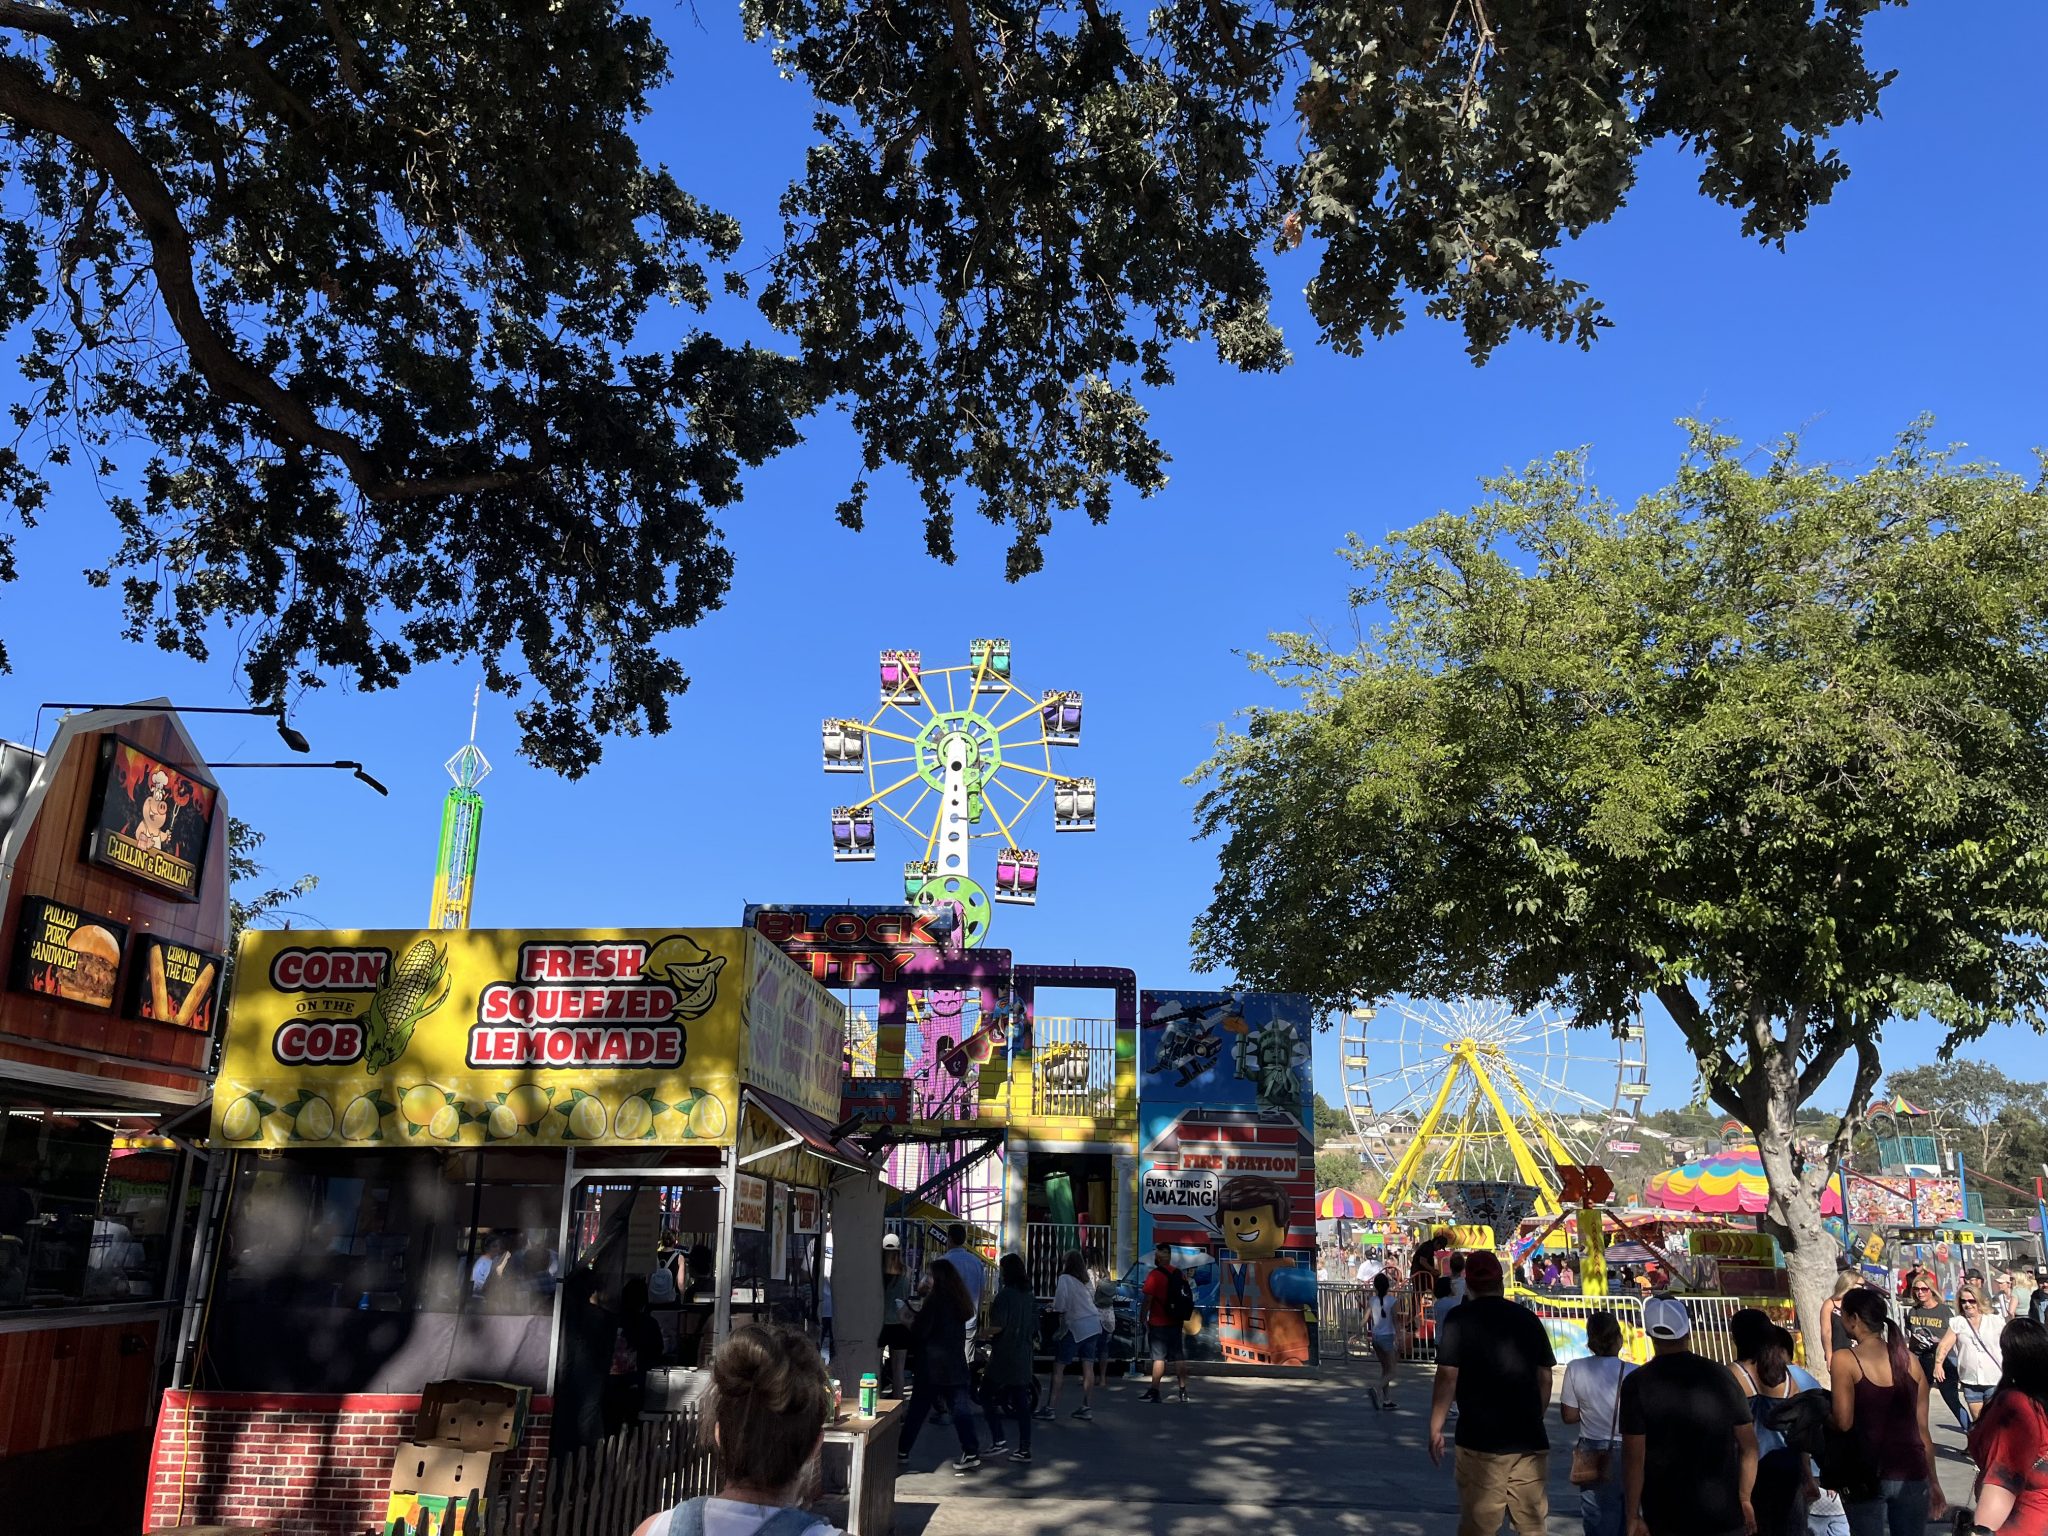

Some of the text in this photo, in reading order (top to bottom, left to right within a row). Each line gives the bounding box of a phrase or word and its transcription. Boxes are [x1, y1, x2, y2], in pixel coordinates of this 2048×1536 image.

[147, 857, 154, 872] &
[154, 854, 192, 887] GRILLIN'
[43, 904, 79, 929] PULLED
[757, 912, 940, 944] BLOCK
[44, 923, 70, 947] PORK
[167, 945, 201, 968] CORN ON
[524, 948, 644, 978] FRESH
[166, 961, 197, 984] THE COB
[276, 953, 385, 986] CORN
[296, 1000, 355, 1013] ON THE
[484, 988, 676, 1024] SQUEEZED
[279, 1025, 361, 1059] COB
[473, 1030, 680, 1061] LEMONADE
[1183, 1154, 1296, 1172] FIRE STATION
[1145, 1178, 1213, 1189] EVERYTHING IS
[1145, 1189, 1217, 1207] AMAZING!
[1945, 1233, 1971, 1242] EXIT
